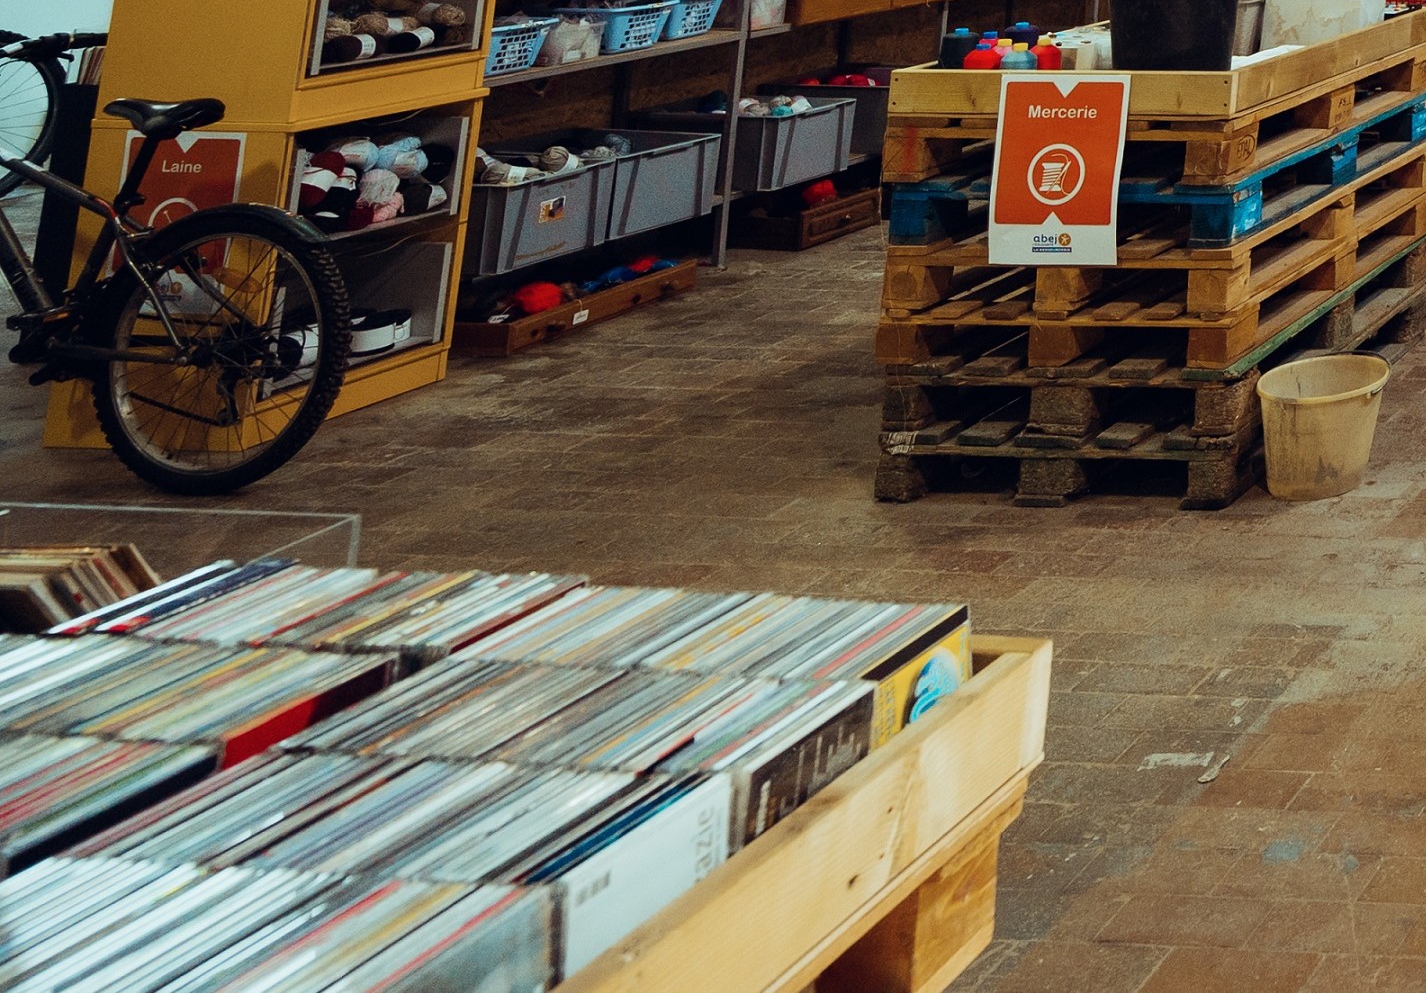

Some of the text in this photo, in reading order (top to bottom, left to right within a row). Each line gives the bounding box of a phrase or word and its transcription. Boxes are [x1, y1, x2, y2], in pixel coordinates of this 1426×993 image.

[1028, 105, 1098, 120] Mercerie
[162, 159, 202, 174] Laine
[1033, 233, 1058, 246] abej
